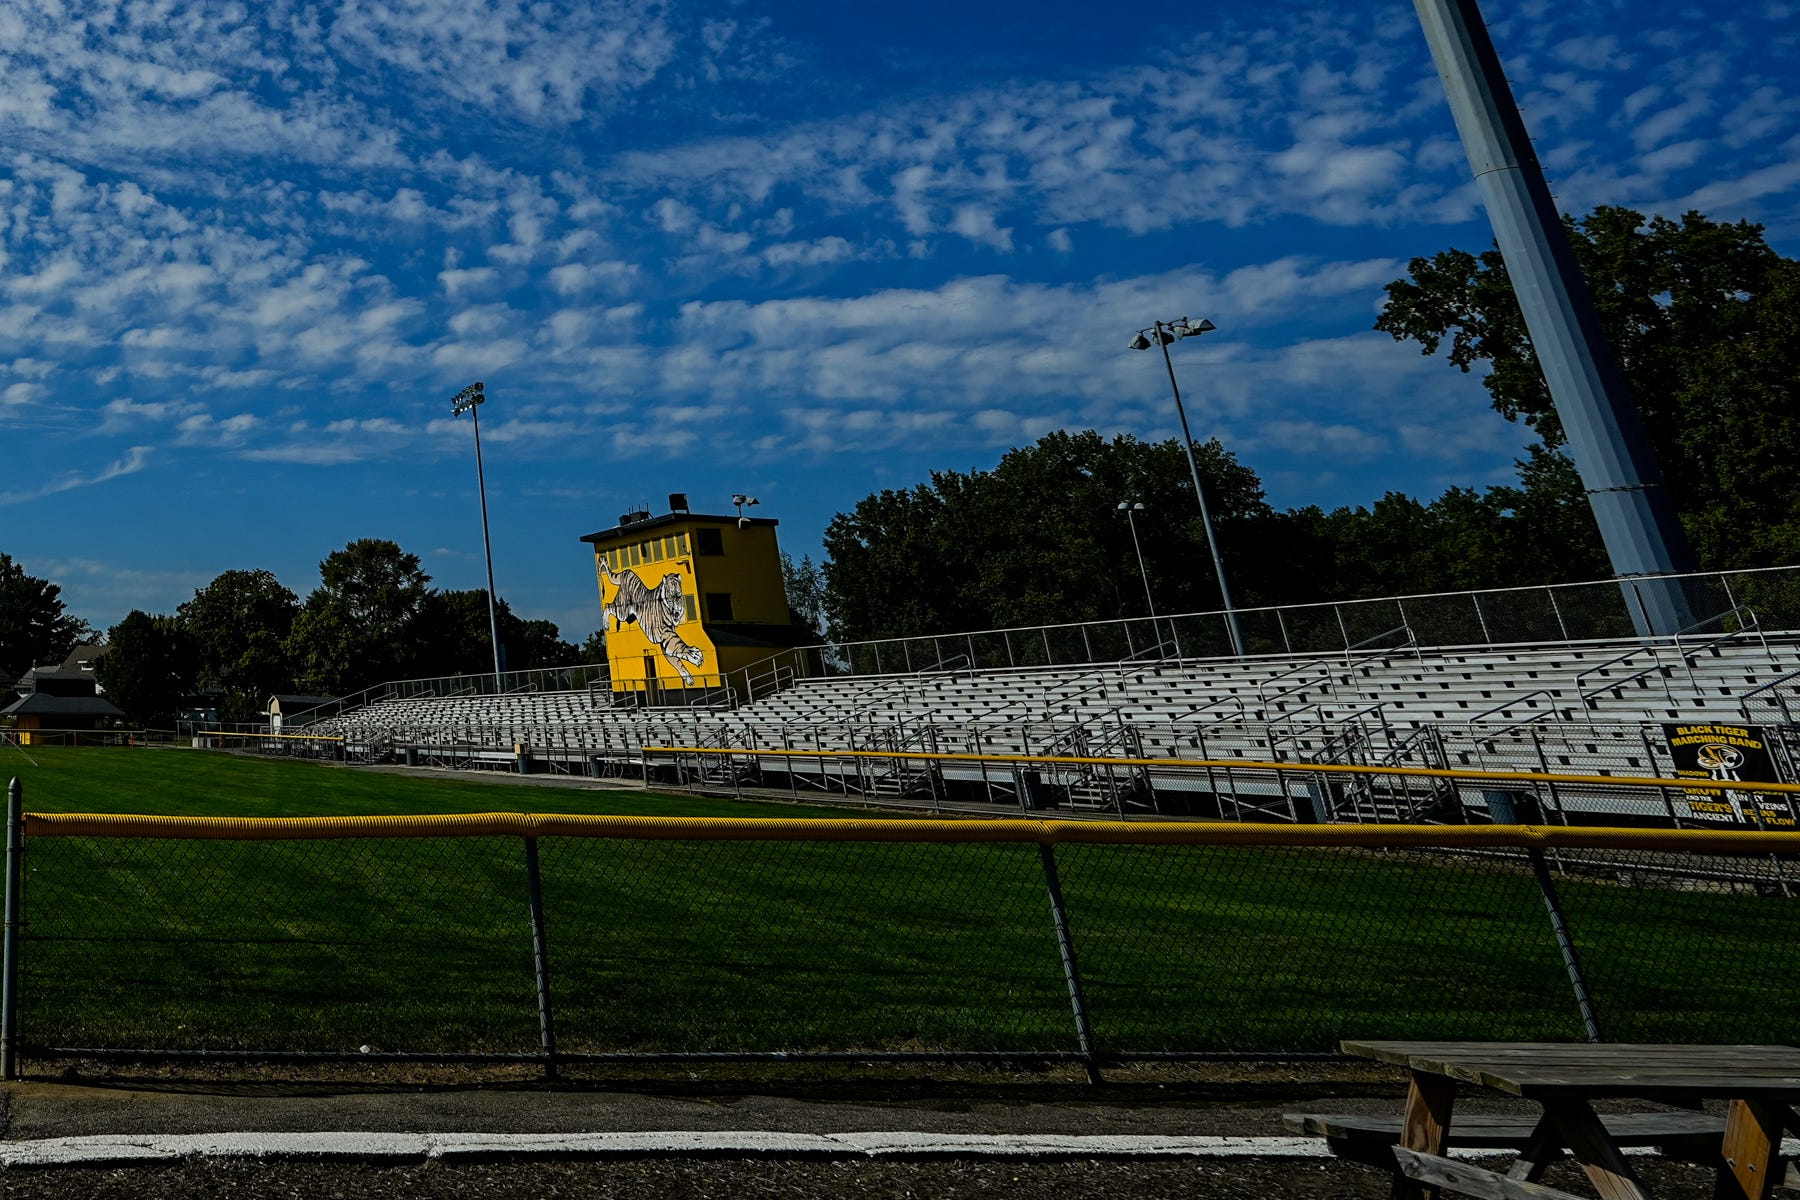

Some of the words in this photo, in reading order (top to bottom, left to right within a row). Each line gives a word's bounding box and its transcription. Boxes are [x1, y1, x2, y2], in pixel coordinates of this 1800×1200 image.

[1676, 725, 1713, 736] BLACK
[1713, 726, 1749, 737] TIGER
[1671, 735, 1727, 747] MARCHING
[1729, 737, 1763, 750] BAND
[1688, 801, 1733, 813] TIGER'S
[1757, 802, 1789, 812] VEINS
[1693, 811, 1734, 823] ANCIENT
[1765, 817, 1796, 827] FLOW
